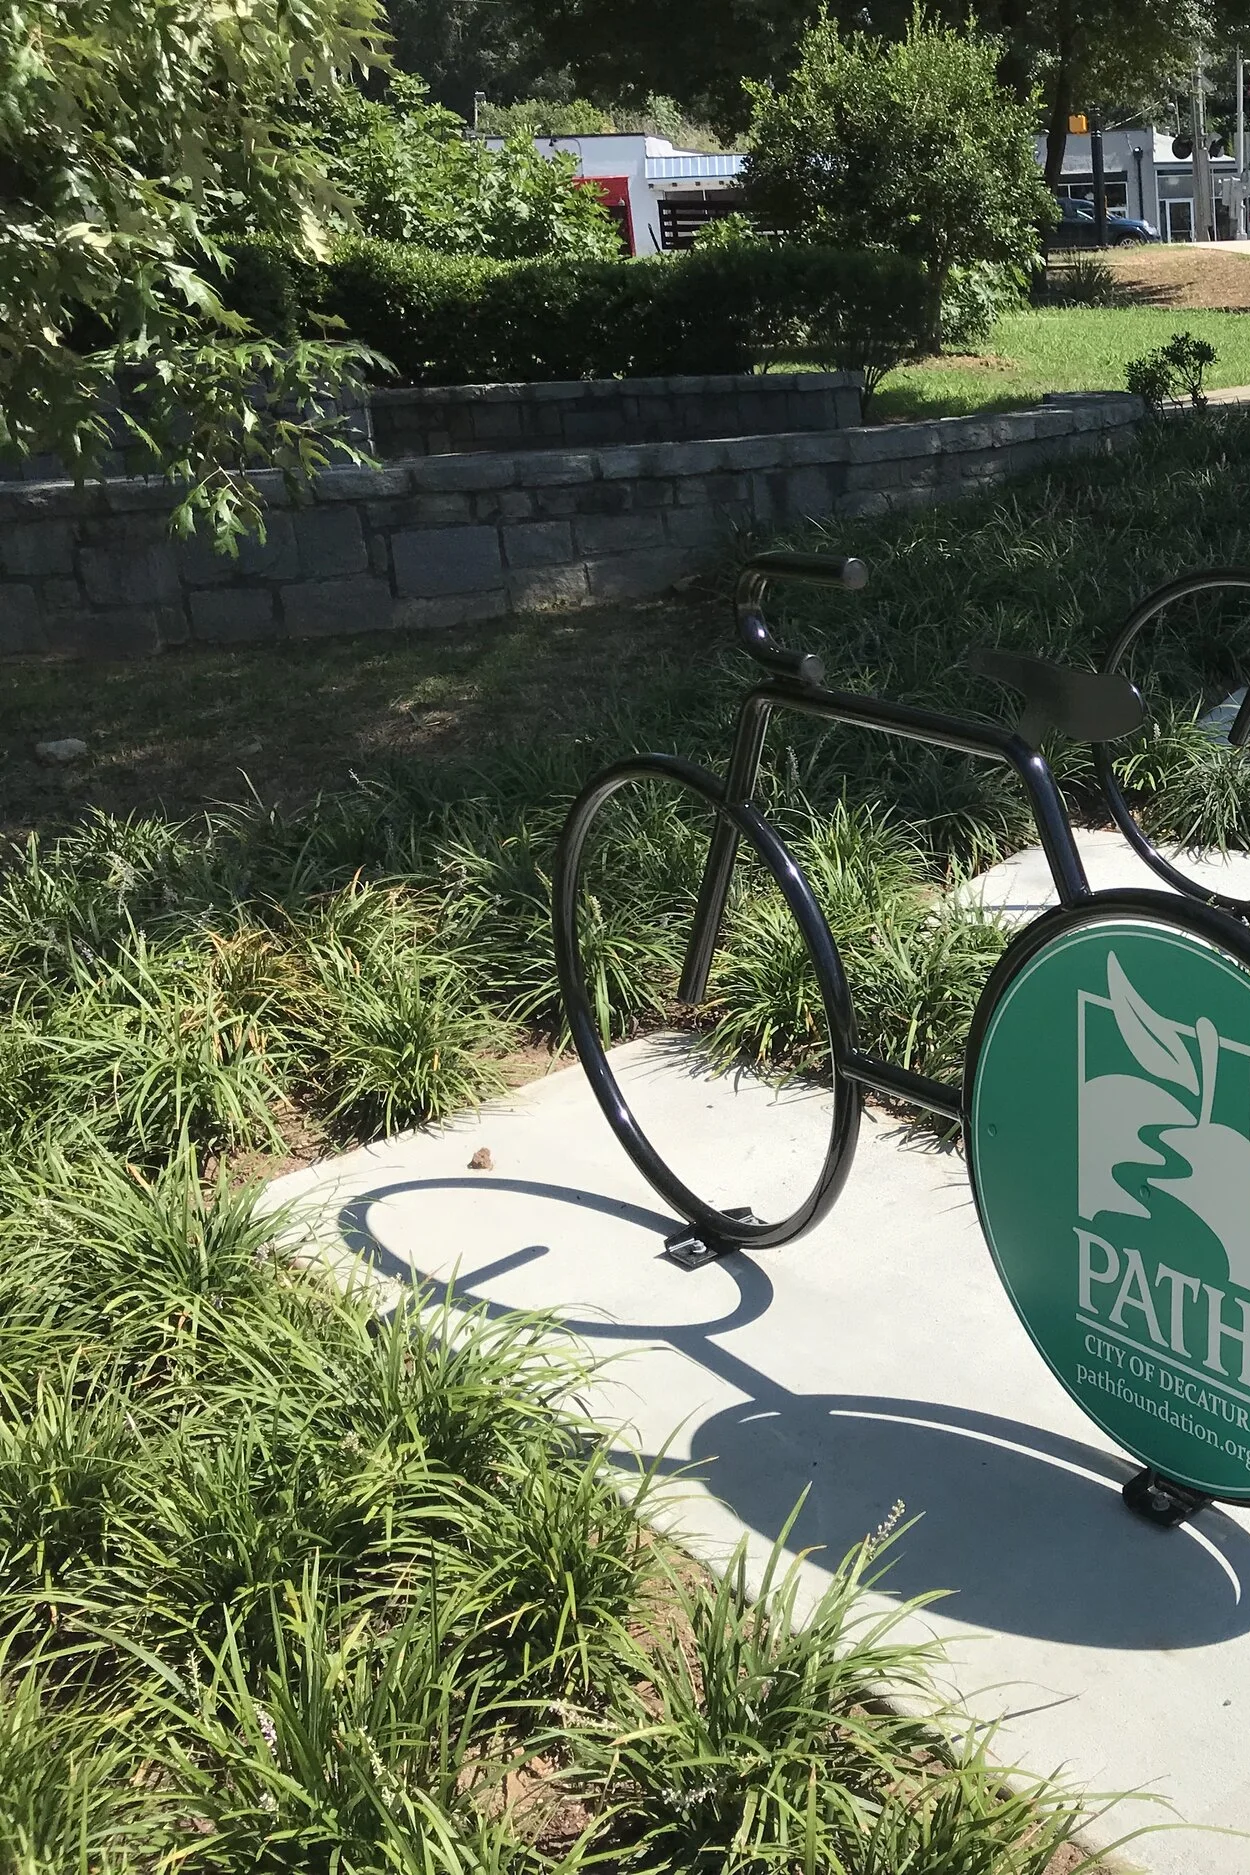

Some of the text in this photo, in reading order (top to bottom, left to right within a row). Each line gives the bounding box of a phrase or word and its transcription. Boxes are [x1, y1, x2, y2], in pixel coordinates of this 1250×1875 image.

[1085, 1334, 1250, 1433] CITY OF DECATUR
